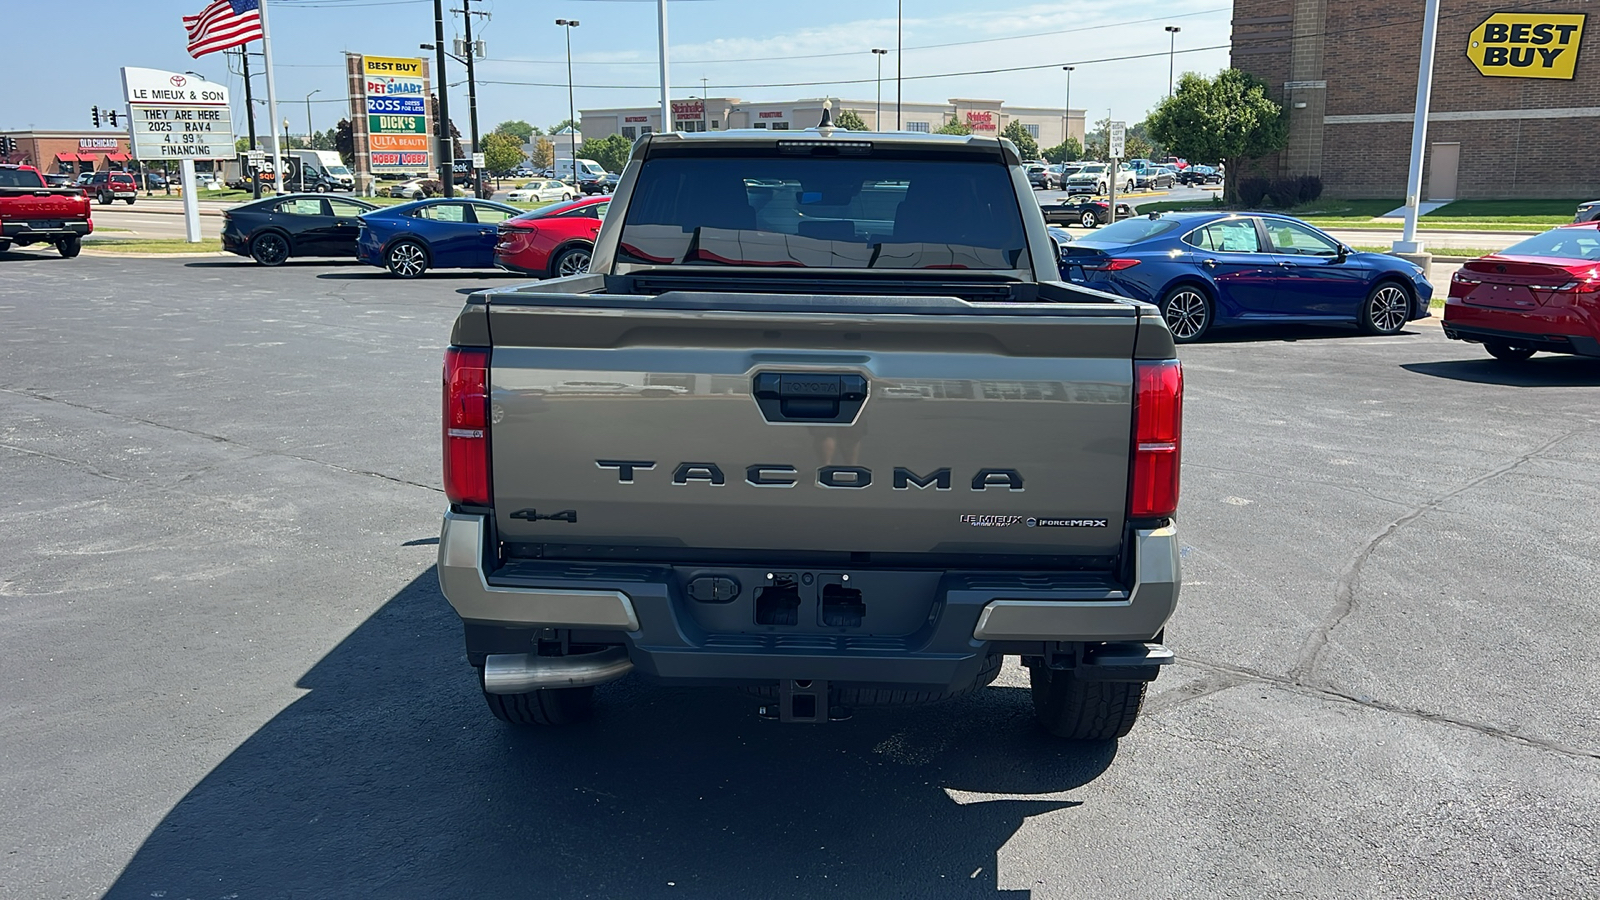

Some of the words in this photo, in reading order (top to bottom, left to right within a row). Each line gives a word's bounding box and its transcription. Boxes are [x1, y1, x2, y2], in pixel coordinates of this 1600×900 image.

[1483, 23, 1578, 45] BEST
[1483, 47, 1566, 68] BUY
[368, 61, 394, 70] BEST
[395, 63, 418, 71] BUY
[367, 80, 423, 94] PETSMART
[133, 89, 148, 99] LE
[152, 90, 186, 100] MIEUX
[189, 91, 197, 100] &
[201, 91, 225, 101] SON
[368, 100, 400, 110] ROSS
[144, 110, 169, 120] THEY
[174, 110, 193, 120] ARE
[198, 110, 220, 120] HERE
[148, 122, 173, 132] 2025
[184, 122, 211, 132] RAV4
[380, 116, 416, 129] DICK'S
[80, 138, 92, 148] OLD
[92, 139, 118, 148] CHICAGO
[373, 136, 398, 146] ULTA
[161, 146, 210, 155] FINANCING
[372, 153, 400, 165] HOBBY
[401, 153, 427, 165] LOBBY
[783, 382, 838, 393] TOYOTA
[595, 459, 1025, 492] TACOMA
[960, 514, 977, 522] LE
[979, 515, 1023, 524] MIEUX
